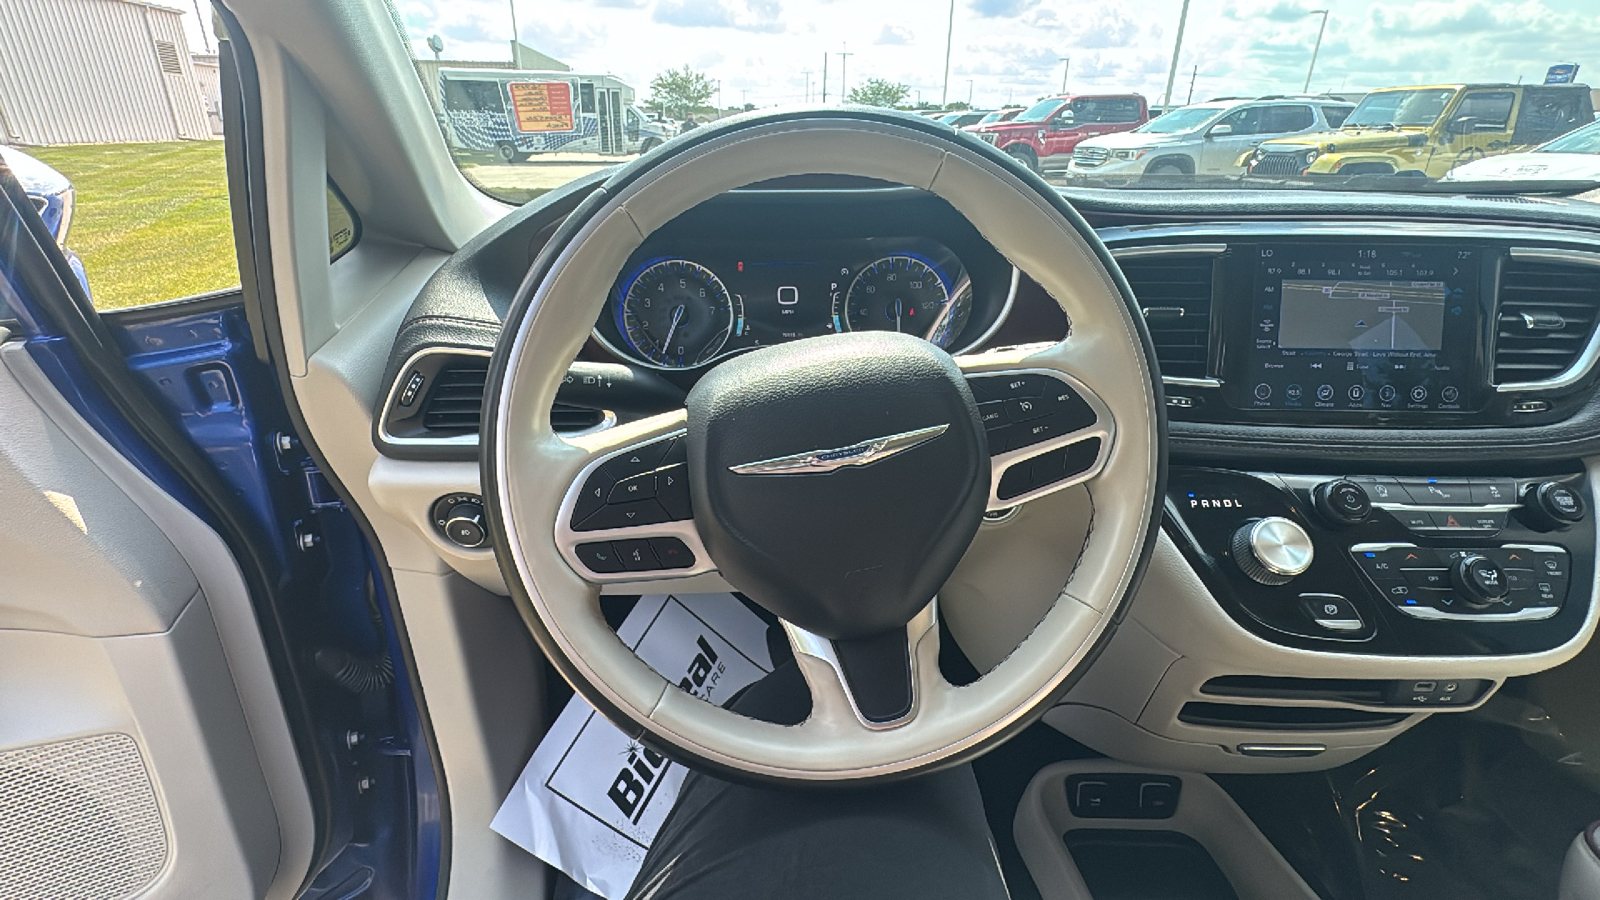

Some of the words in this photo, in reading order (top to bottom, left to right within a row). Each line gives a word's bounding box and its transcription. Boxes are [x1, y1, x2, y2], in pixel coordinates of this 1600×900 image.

[1261, 249, 1274, 258] LO
[657, 283, 665, 292] 4
[679, 279, 687, 289] 5
[831, 282, 838, 290] P
[909, 281, 923, 289] 100
[699, 288, 706, 298] 6
[644, 298, 651, 308] 3
[921, 302, 935, 310] 120
[709, 306, 716, 315] 7
[641, 320, 649, 329] 2
[677, 346, 685, 355] 0
